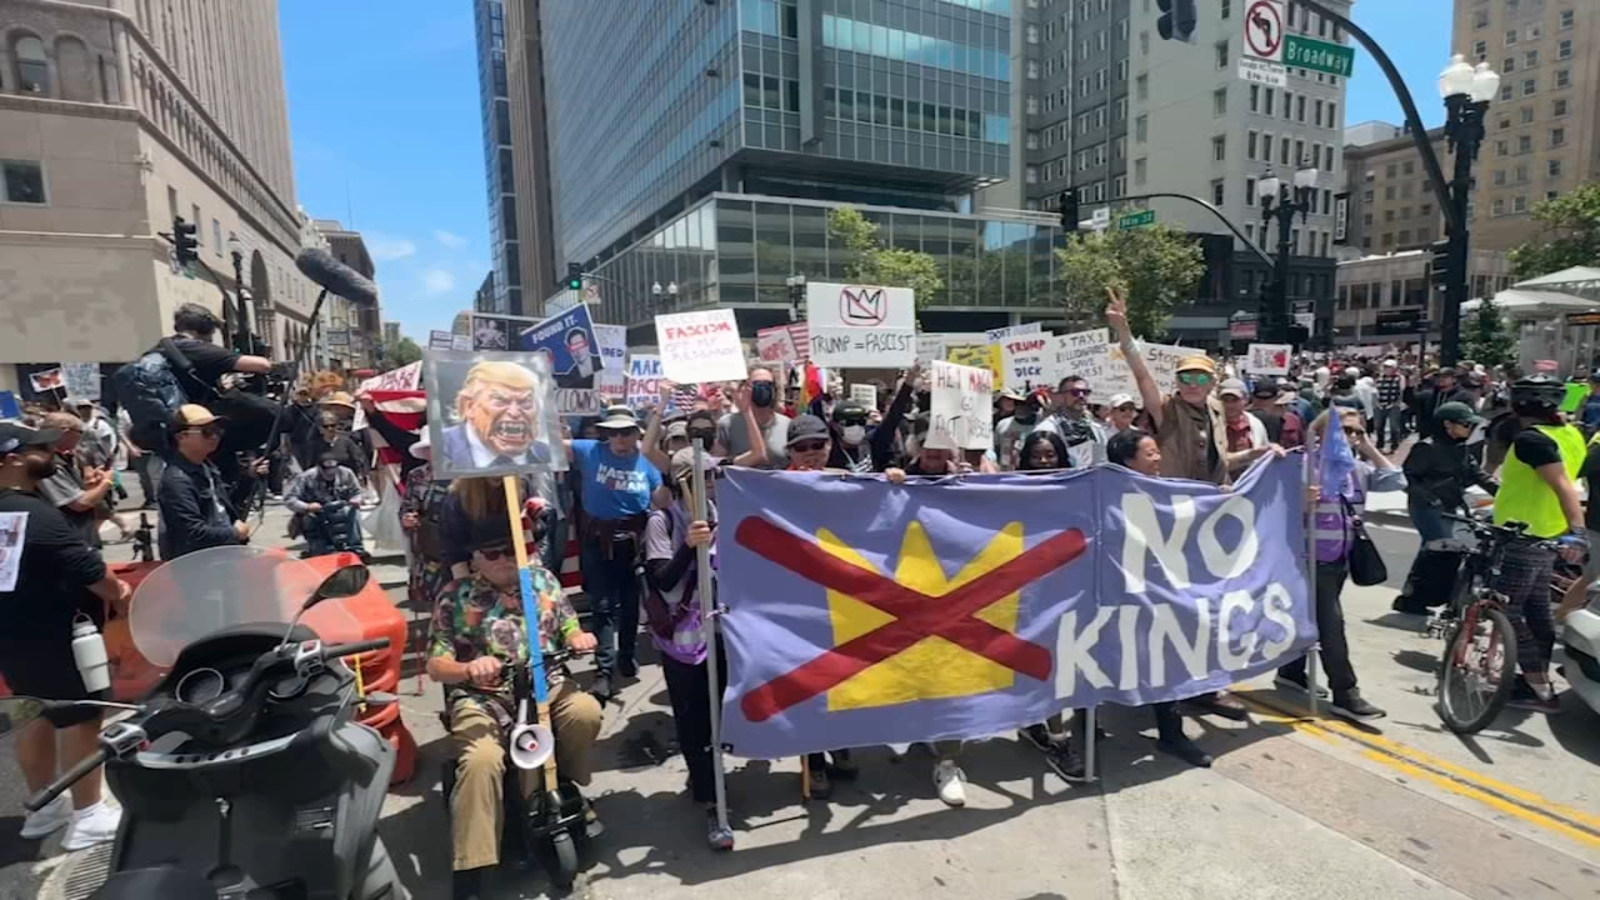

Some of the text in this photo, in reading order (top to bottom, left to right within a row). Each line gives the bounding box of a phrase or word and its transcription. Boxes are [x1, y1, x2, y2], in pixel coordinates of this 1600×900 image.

[1287, 41, 1350, 75] Broadway
[665, 321, 732, 340] FASCISM
[1069, 332, 1096, 347] TAX
[810, 334, 851, 354] TRUMP
[866, 332, 913, 353] FASCIST
[1006, 339, 1046, 355] TRUMP
[630, 359, 663, 376] MAK
[1070, 356, 1096, 370] SAVE
[1147, 347, 1180, 371] Stop
[1014, 366, 1042, 378] DICK
[1121, 493, 1259, 594] NO
[1055, 582, 1297, 700] KINGS
